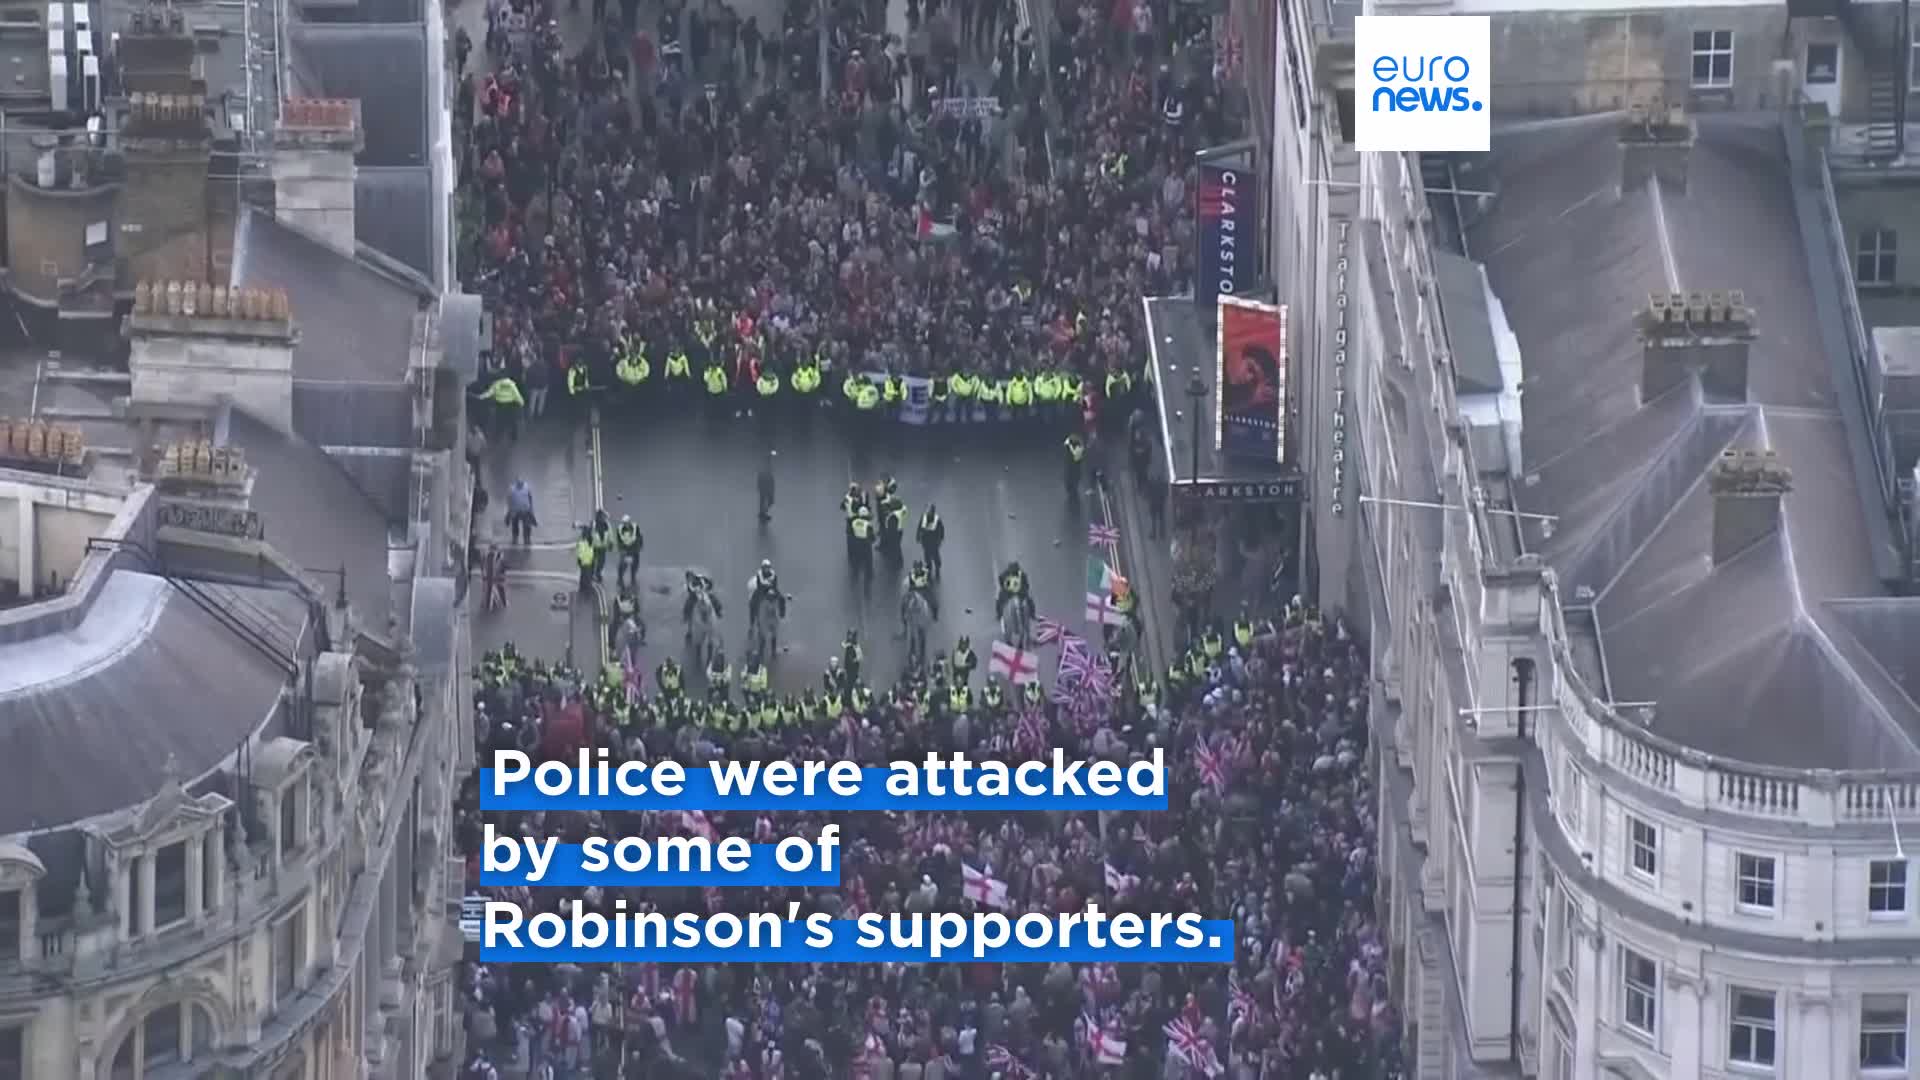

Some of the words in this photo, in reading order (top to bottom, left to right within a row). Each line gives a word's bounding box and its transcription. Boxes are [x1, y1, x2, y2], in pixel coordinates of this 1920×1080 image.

[1219, 170, 1237, 294] CLARKSTO
[1335, 222, 1349, 377] Trafalgar
[1332, 390, 1344, 515] Theatre
